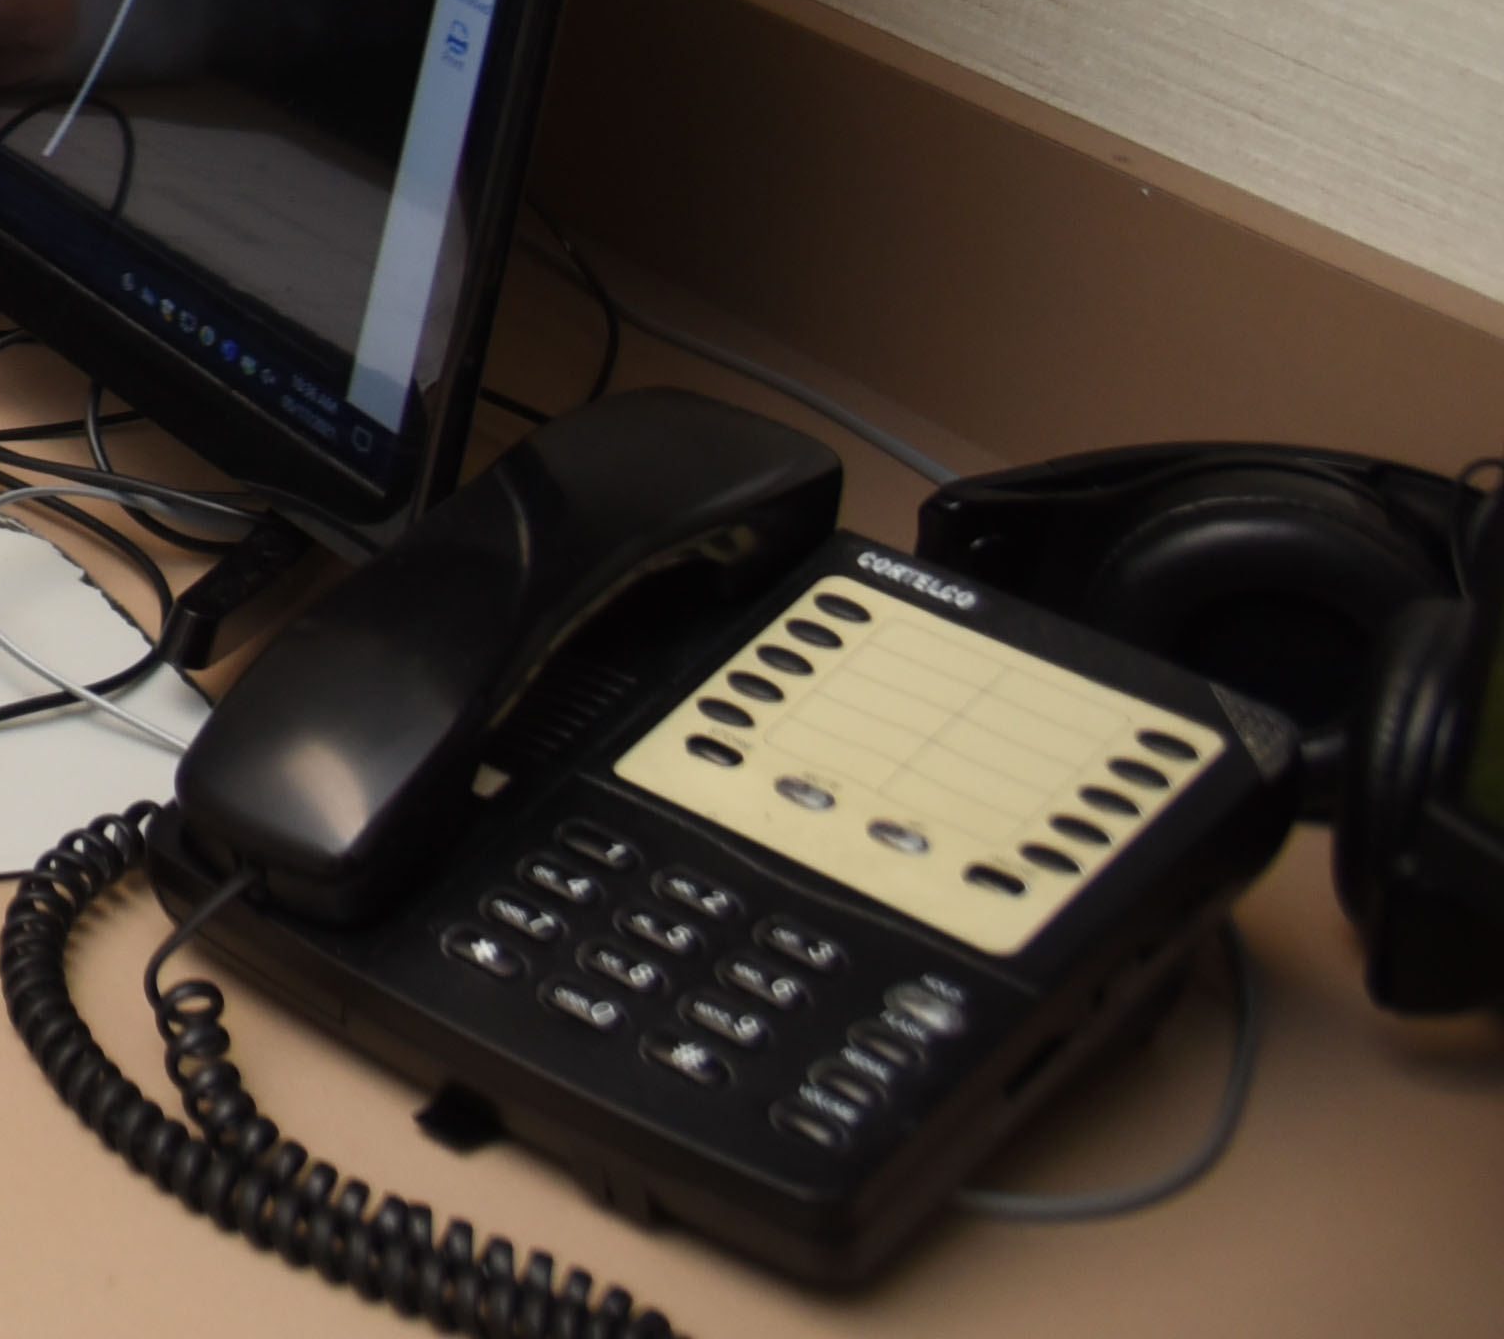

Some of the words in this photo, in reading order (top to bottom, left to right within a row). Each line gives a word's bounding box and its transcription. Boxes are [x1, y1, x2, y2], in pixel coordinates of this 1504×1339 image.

[856, 550, 977, 610] CORTELCO
[568, 879, 589, 897] 4
[702, 891, 728, 913] 2
[529, 913, 555, 933] 7
[667, 926, 691, 947] 5
[808, 942, 834, 964] 3
[629, 964, 654, 986] 8
[772, 979, 796, 1000] 6
[734, 1016, 759, 1039] 9
